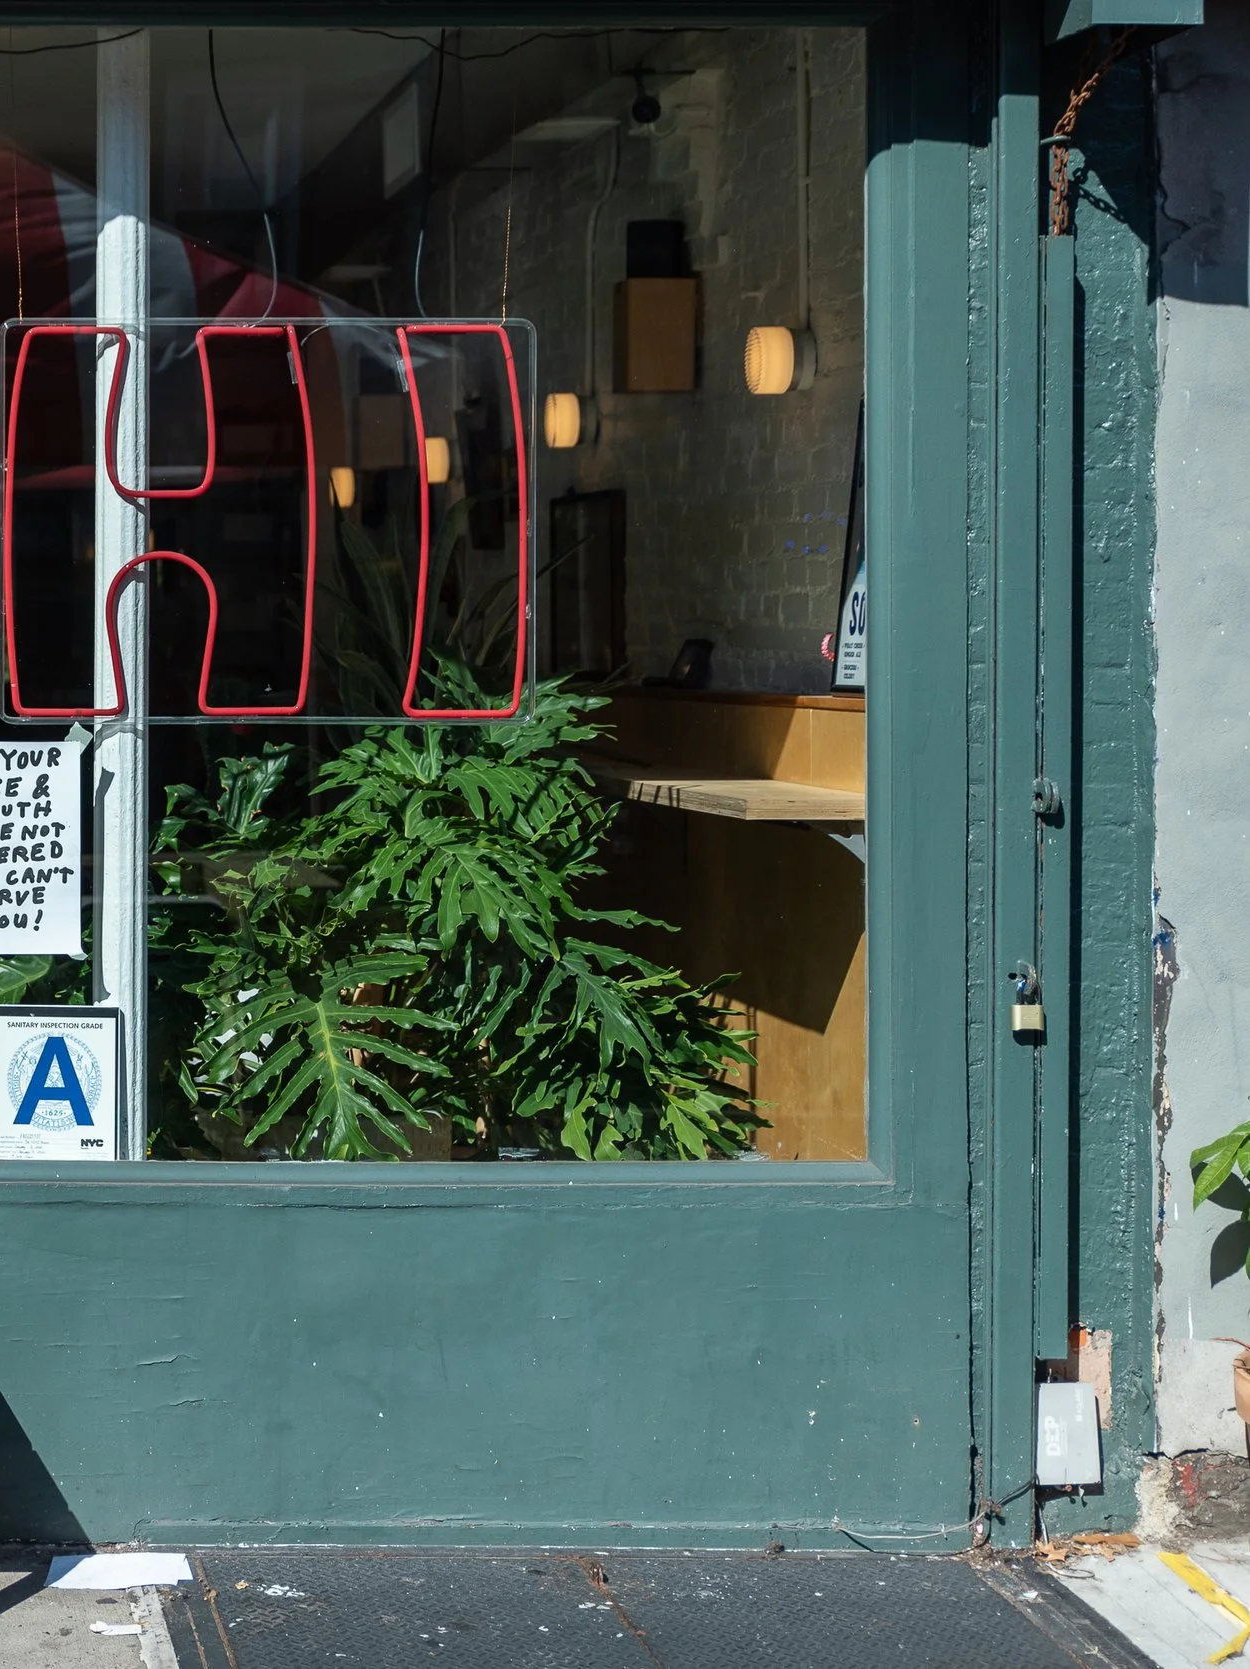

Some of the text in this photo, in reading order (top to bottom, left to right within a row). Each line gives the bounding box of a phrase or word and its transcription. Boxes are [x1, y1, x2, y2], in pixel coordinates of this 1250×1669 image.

[0, 747, 62, 771] YOUR
[32, 773, 50, 799] &
[21, 821, 66, 841] NOT
[6, 866, 75, 886] CAN'T
[7, 1021, 103, 1030] SANITARY INSPECTION GRADE
[13, 1036, 95, 1126] A
[80, 1138, 104, 1147] NYC
[1043, 1415, 1061, 1457] DEP
